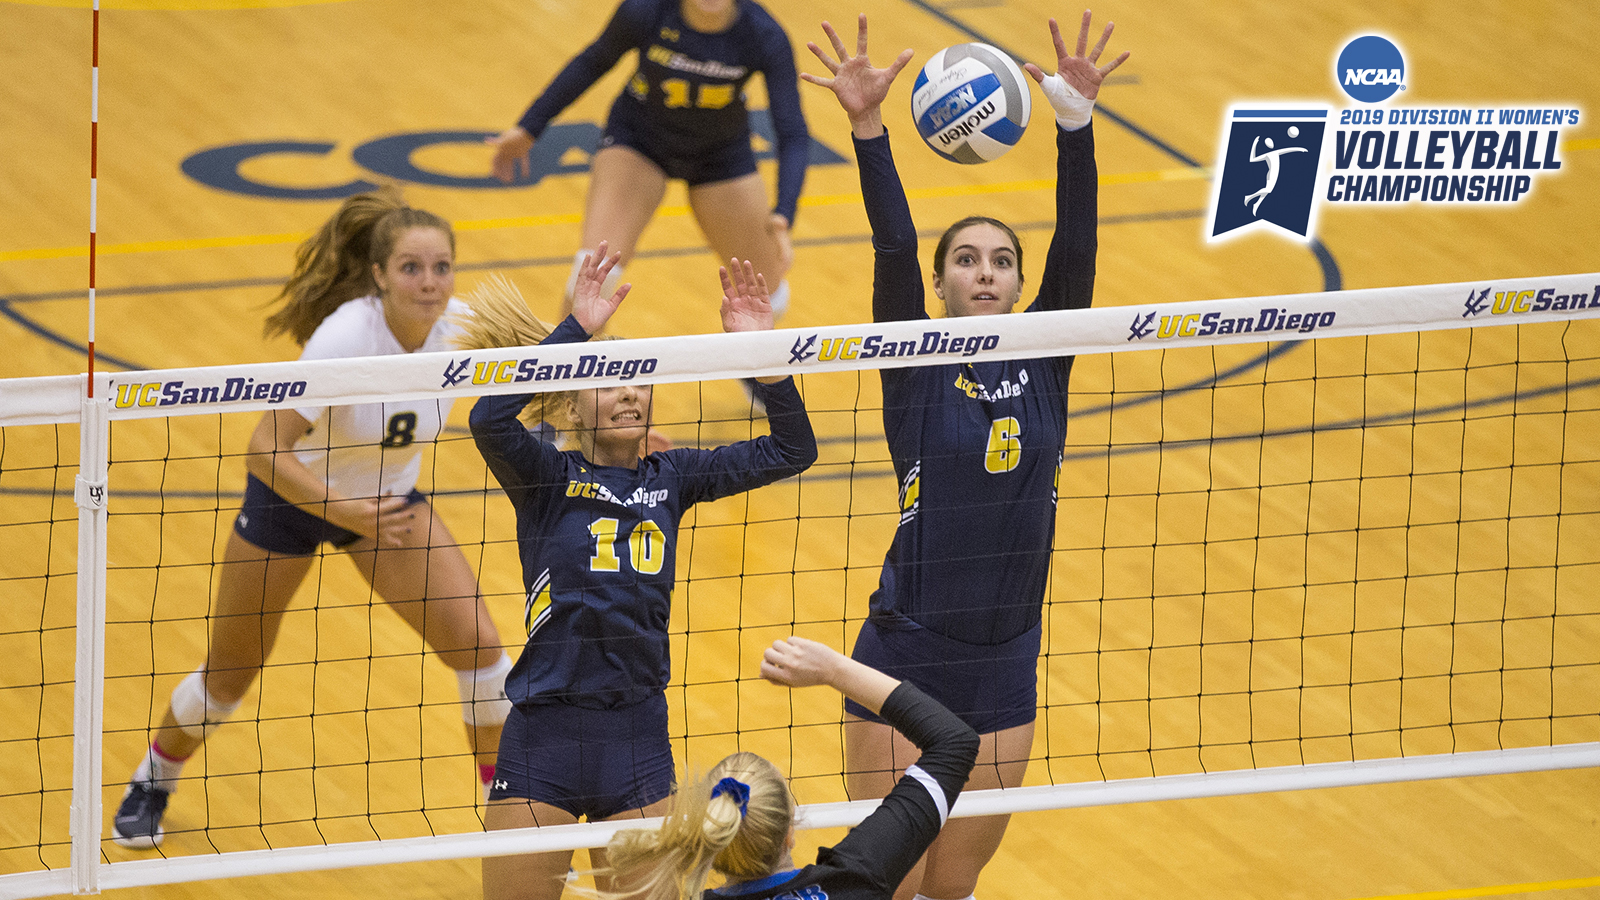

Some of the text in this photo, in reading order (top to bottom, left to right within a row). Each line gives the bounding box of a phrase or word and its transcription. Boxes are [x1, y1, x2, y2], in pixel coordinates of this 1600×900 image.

[929, 83, 978, 130] NCAA
[938, 101, 996, 146] molten
[381, 411, 417, 449] 8
[984, 416, 1022, 474] 6
[587, 517, 666, 575] 10
